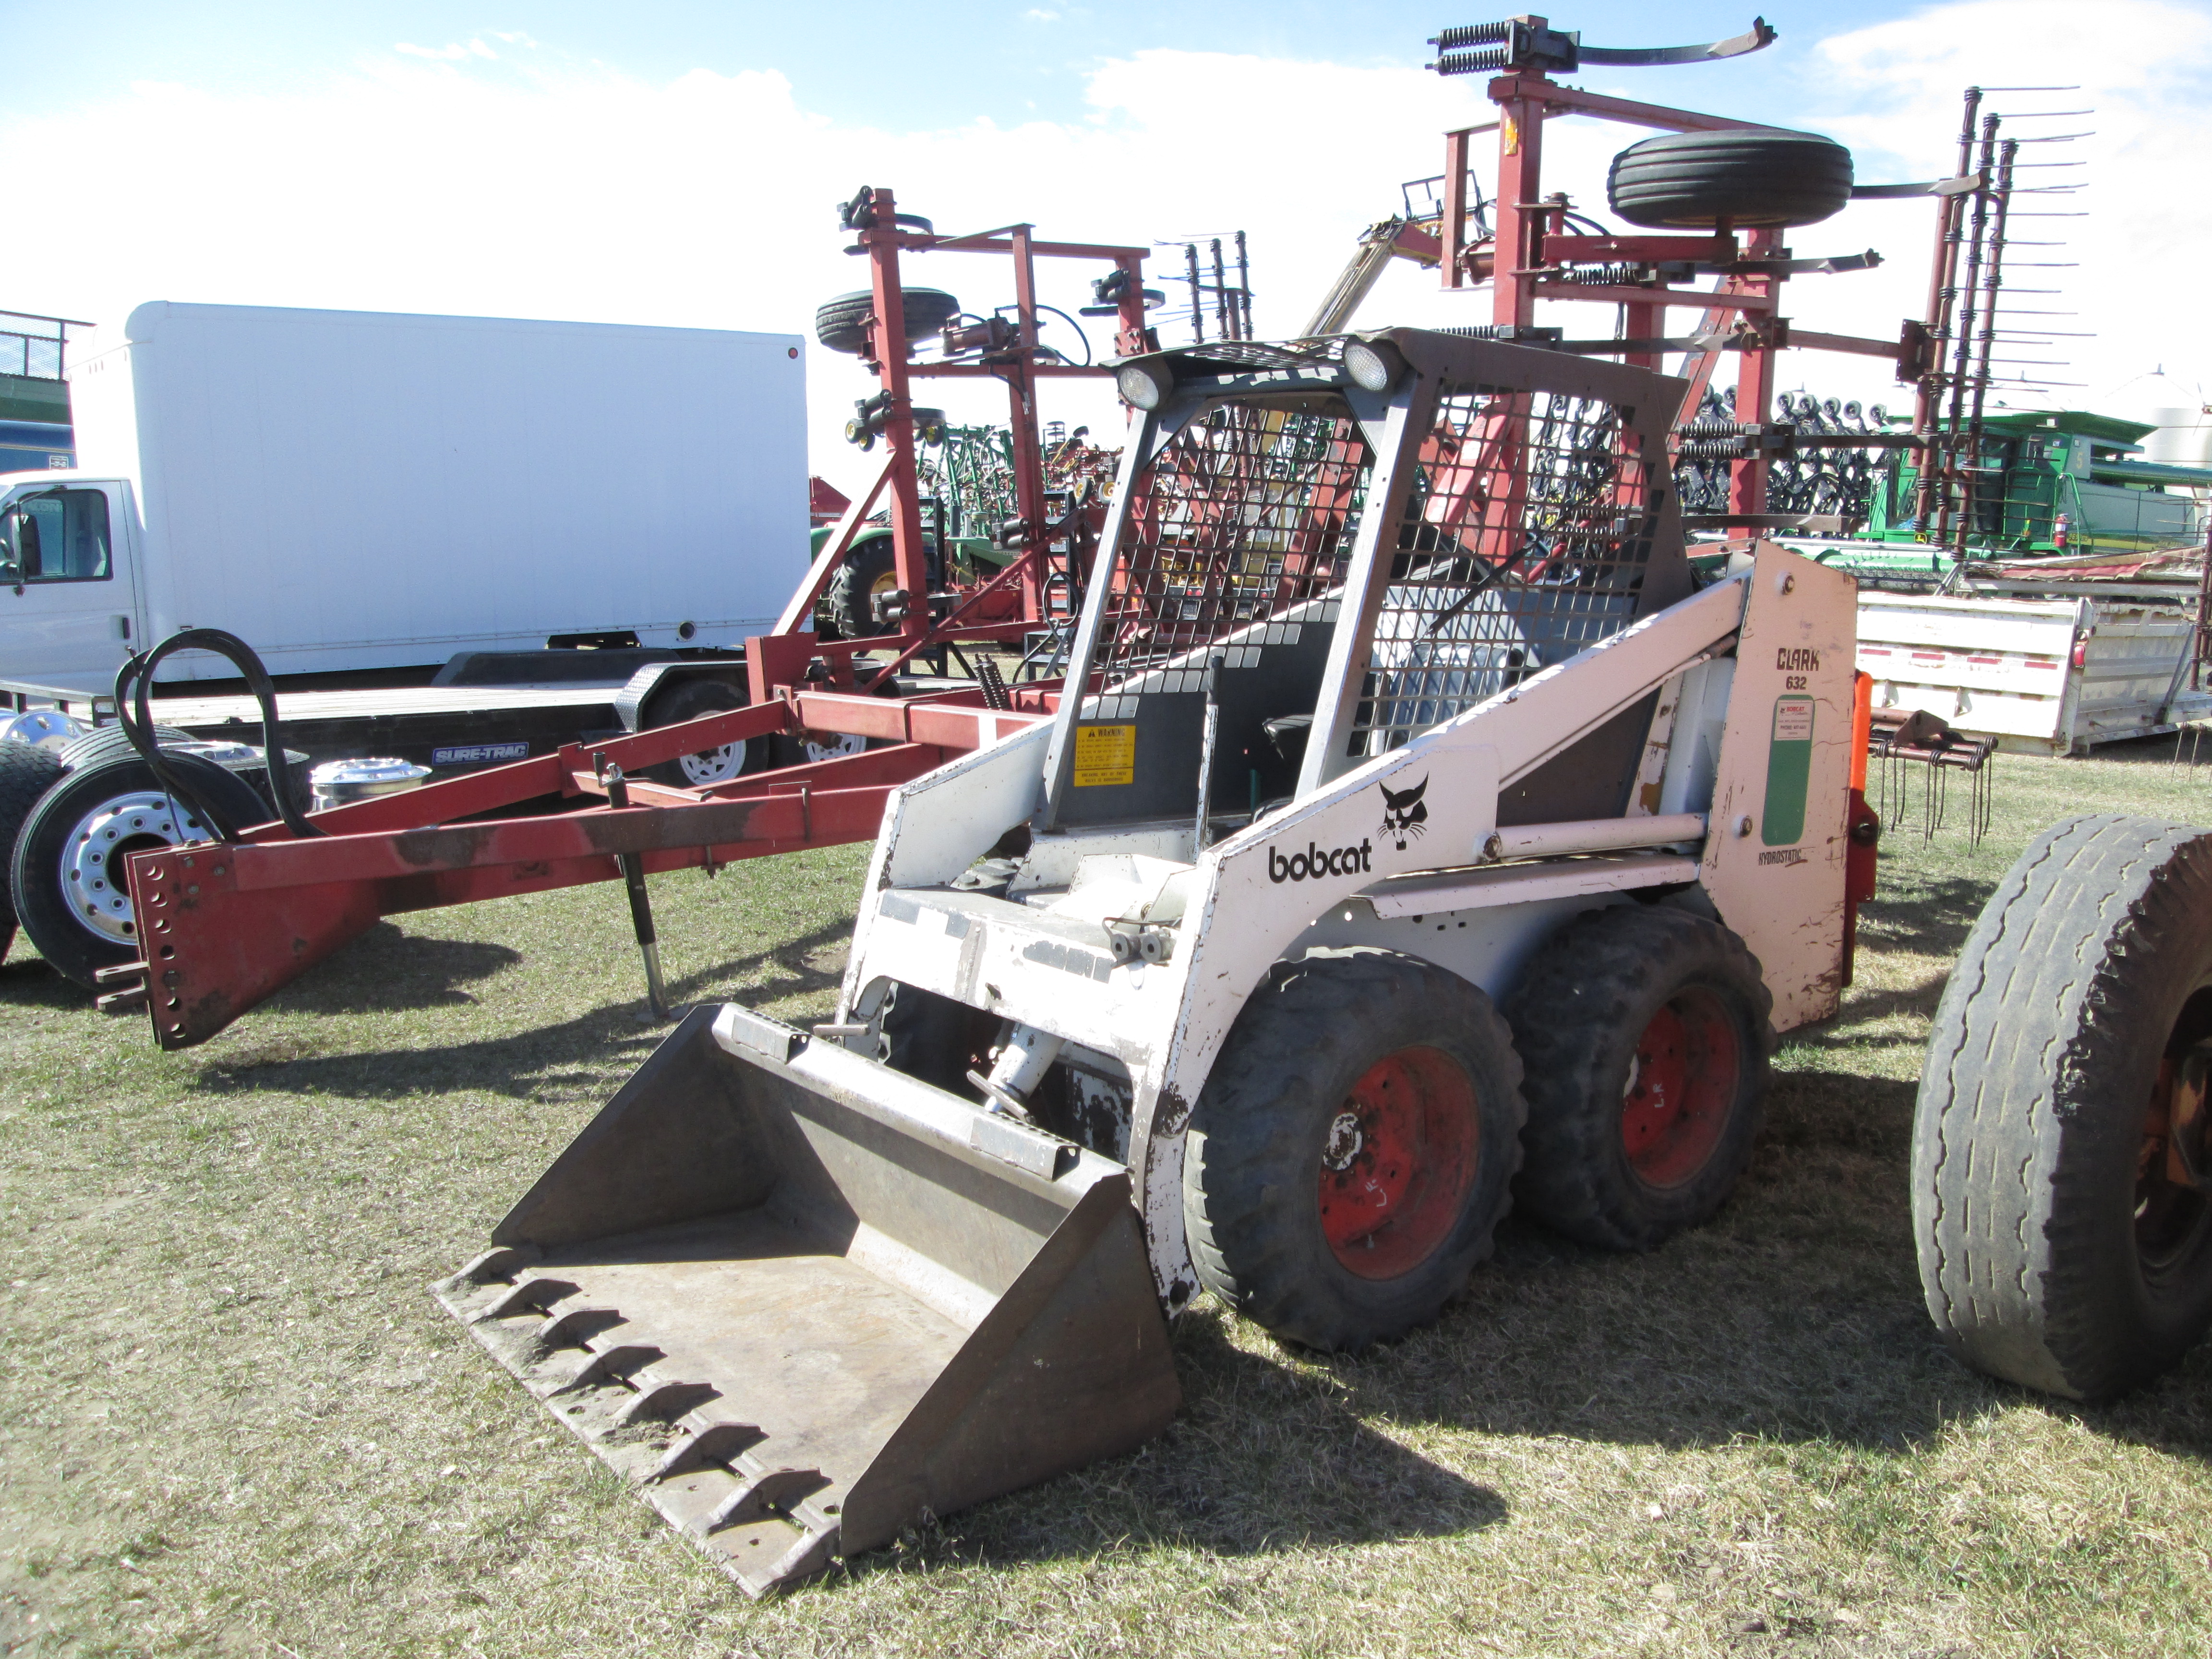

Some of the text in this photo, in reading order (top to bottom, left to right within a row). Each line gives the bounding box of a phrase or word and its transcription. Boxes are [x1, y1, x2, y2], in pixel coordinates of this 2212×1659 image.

[1777, 648, 1819, 671] CLARK
[1786, 676, 1807, 690] 632
[1098, 728, 1126, 737] WARNING
[435, 745, 526, 763] SURE-TRAC
[1269, 838, 1372, 884] bobcat
[1759, 848, 1802, 866] HYDROSTATIC
